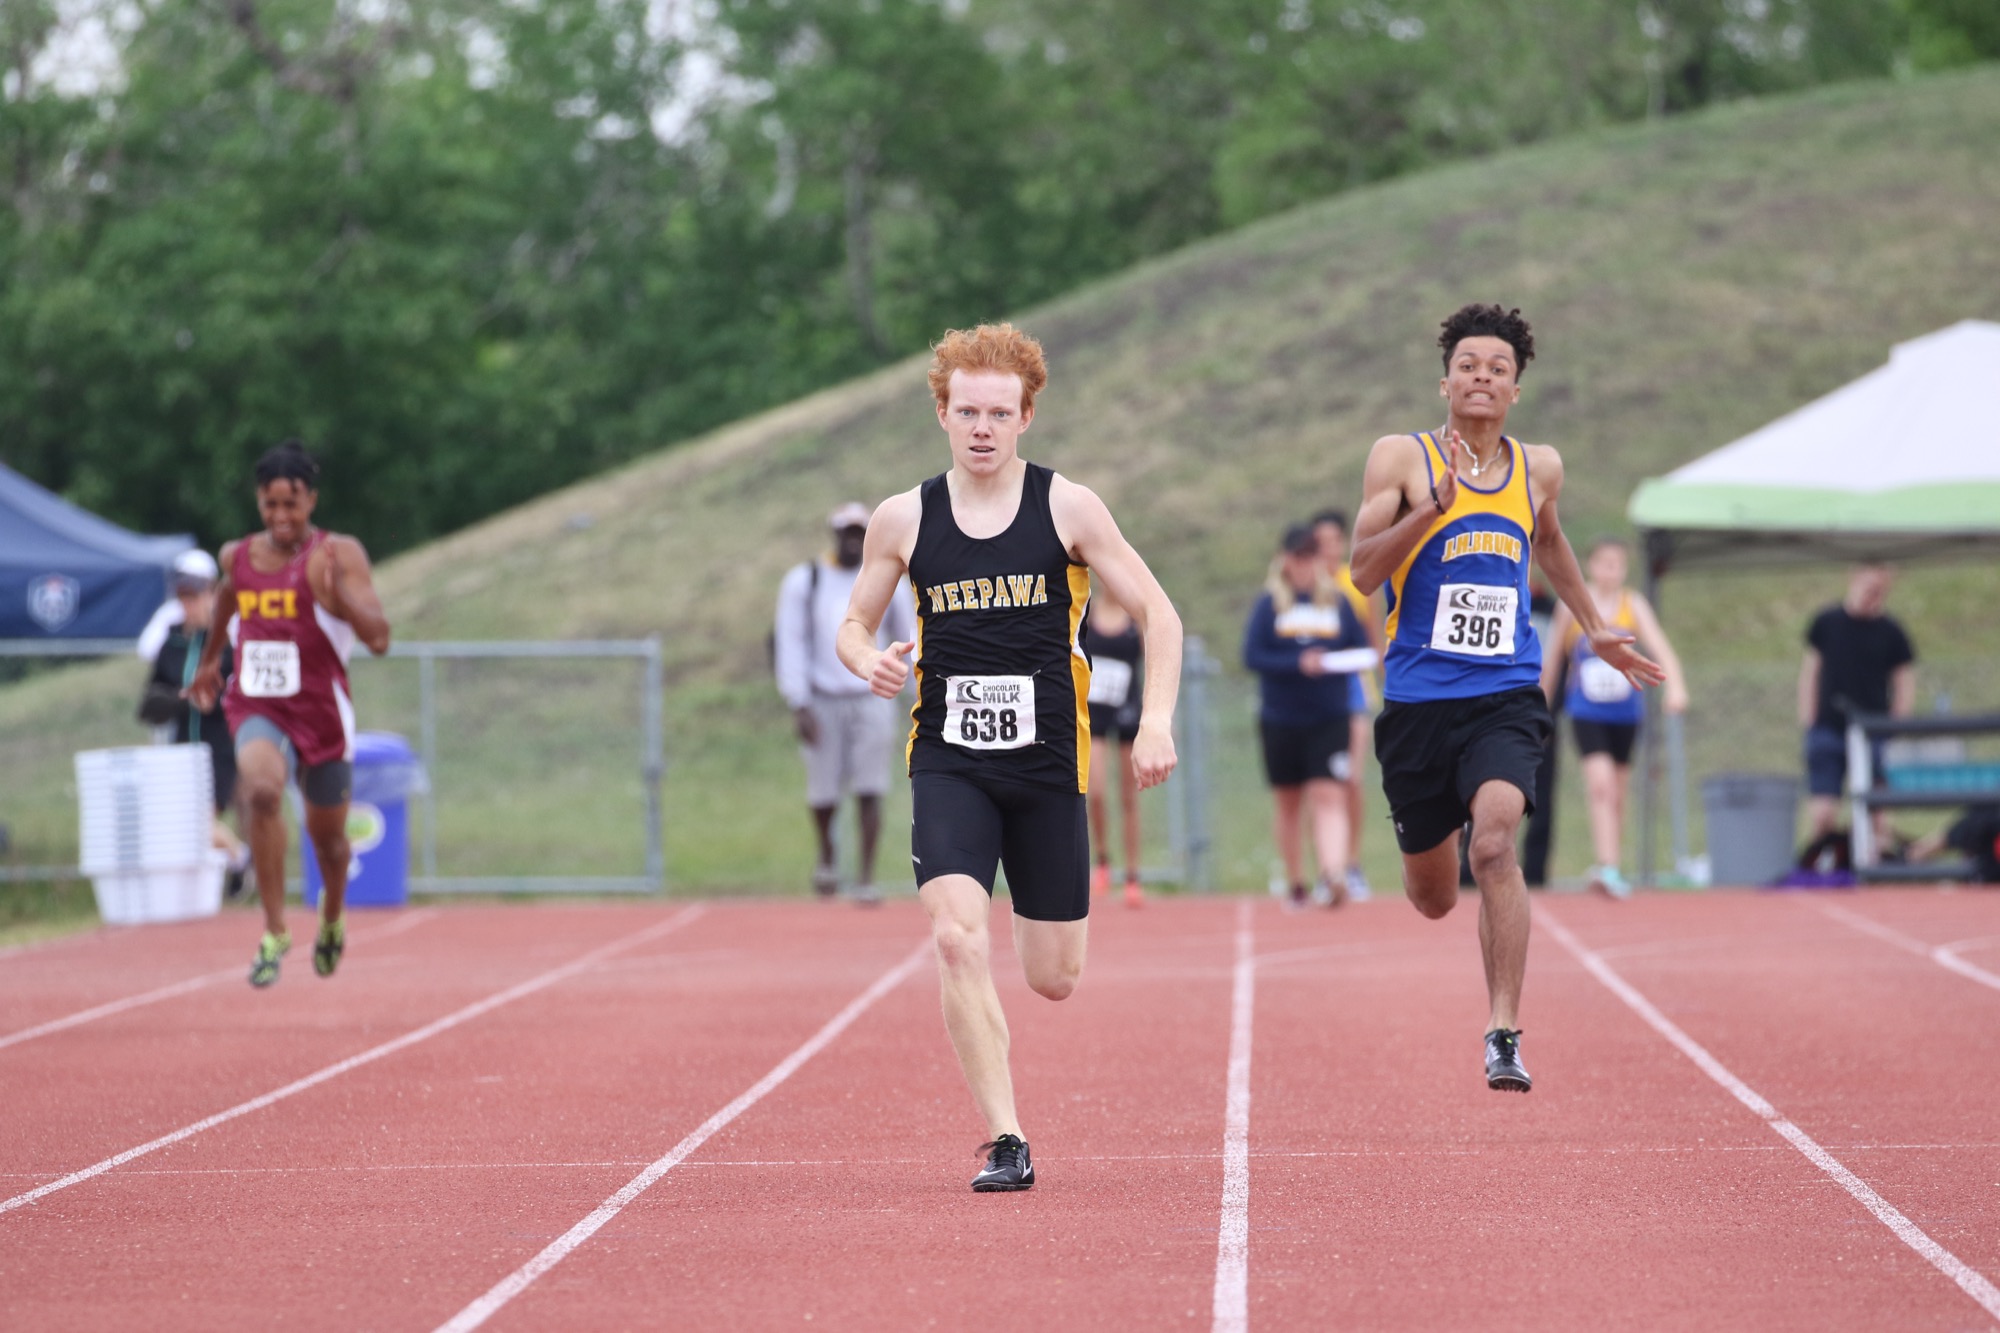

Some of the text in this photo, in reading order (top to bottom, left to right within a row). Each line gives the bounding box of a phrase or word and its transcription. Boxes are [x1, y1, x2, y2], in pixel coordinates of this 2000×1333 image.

[237, 589, 297, 620] PCI
[927, 574, 1048, 613] NEEPAWA
[1477, 600, 1506, 613] MILK
[1448, 613, 1502, 649] 396
[982, 684, 1021, 693] CHOCOLATE
[982, 692, 1021, 704] MILK
[960, 708, 1018, 742] 638
